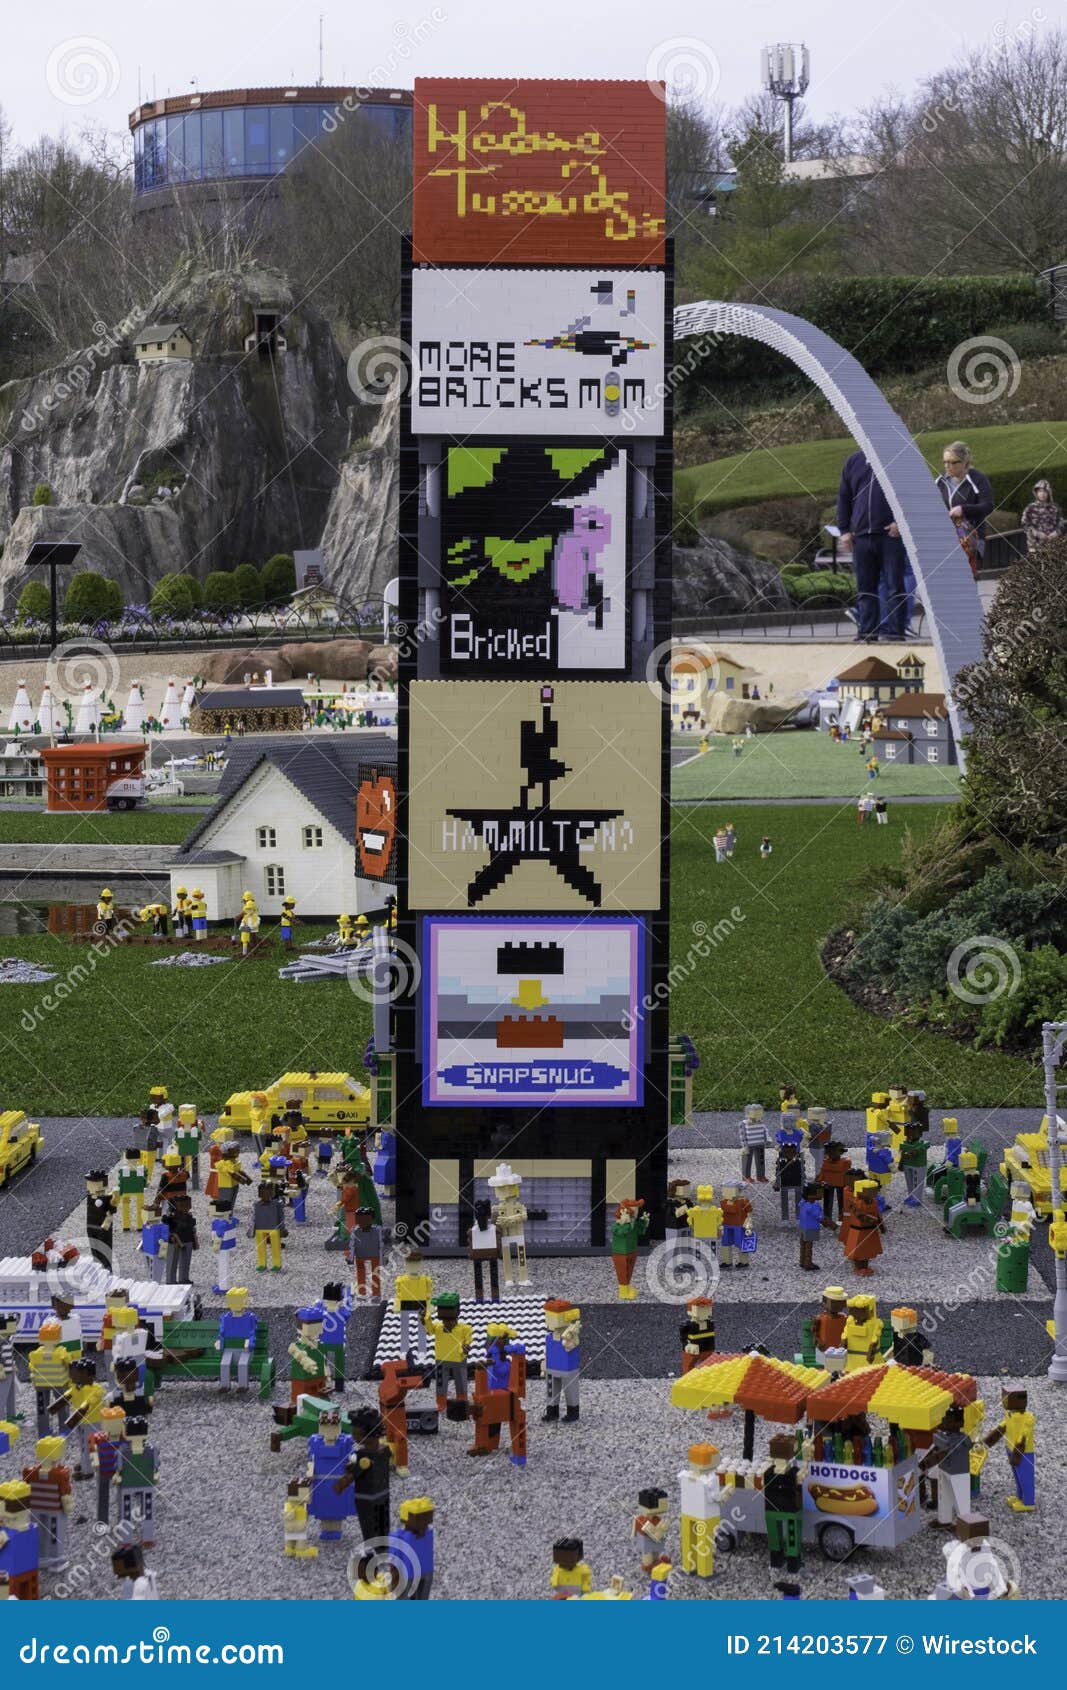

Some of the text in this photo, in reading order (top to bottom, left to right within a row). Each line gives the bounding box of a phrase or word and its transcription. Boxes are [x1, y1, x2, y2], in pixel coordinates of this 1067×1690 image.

[419, 341, 516, 372] MORE
[419, 377, 569, 408] BRICKS
[451, 613, 550, 659] Bricked
[336, 1110, 358, 1119] TAXI
[810, 1465, 877, 1482] HOTDOGS
